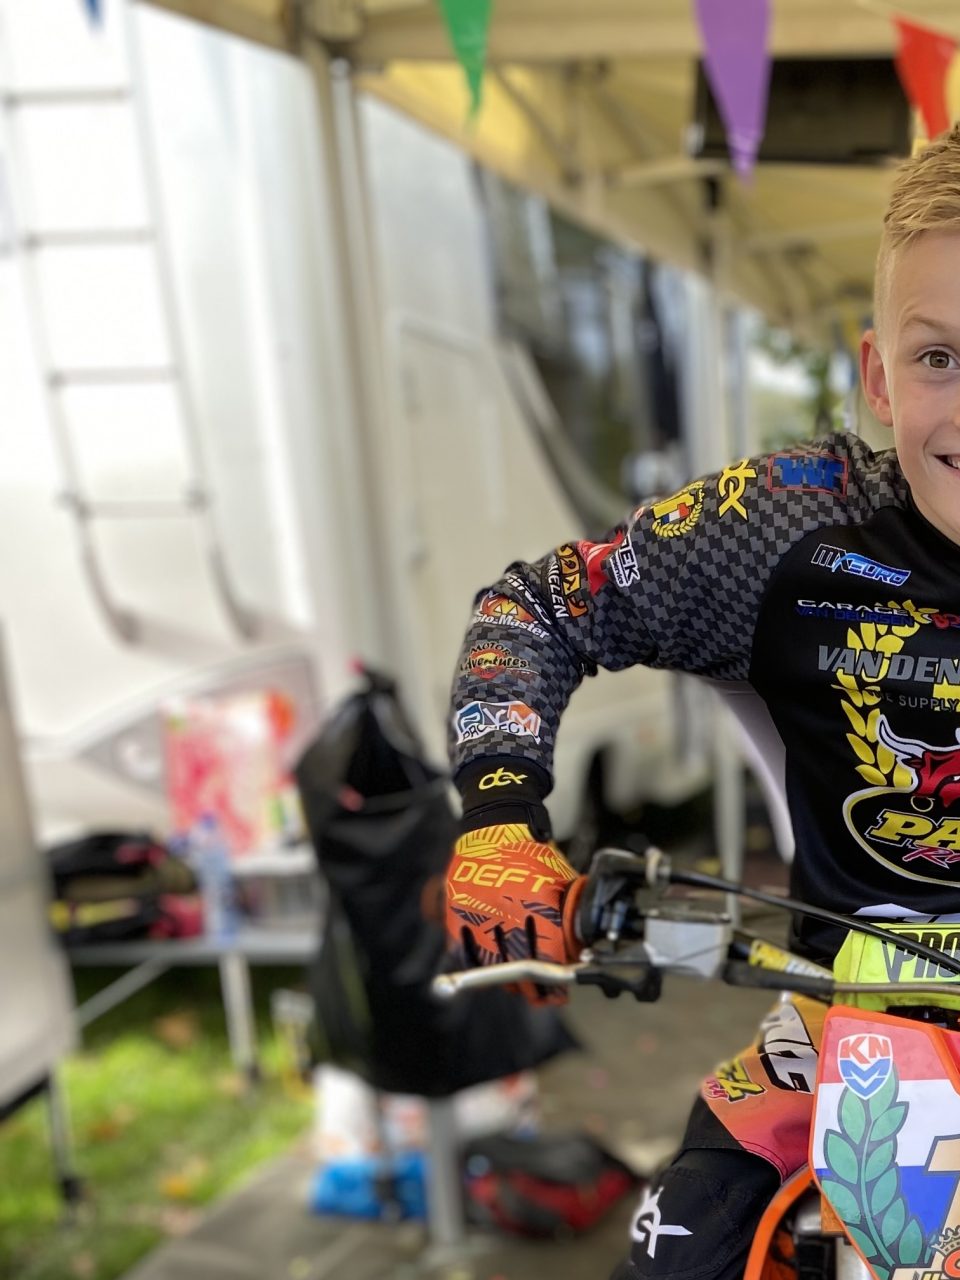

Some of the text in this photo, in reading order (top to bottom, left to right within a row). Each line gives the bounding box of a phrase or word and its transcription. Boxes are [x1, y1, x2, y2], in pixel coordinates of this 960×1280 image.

[818, 645, 883, 678] VAN
[899, 694, 959, 713] SUPPLY
[453, 860, 556, 893] DEFT
